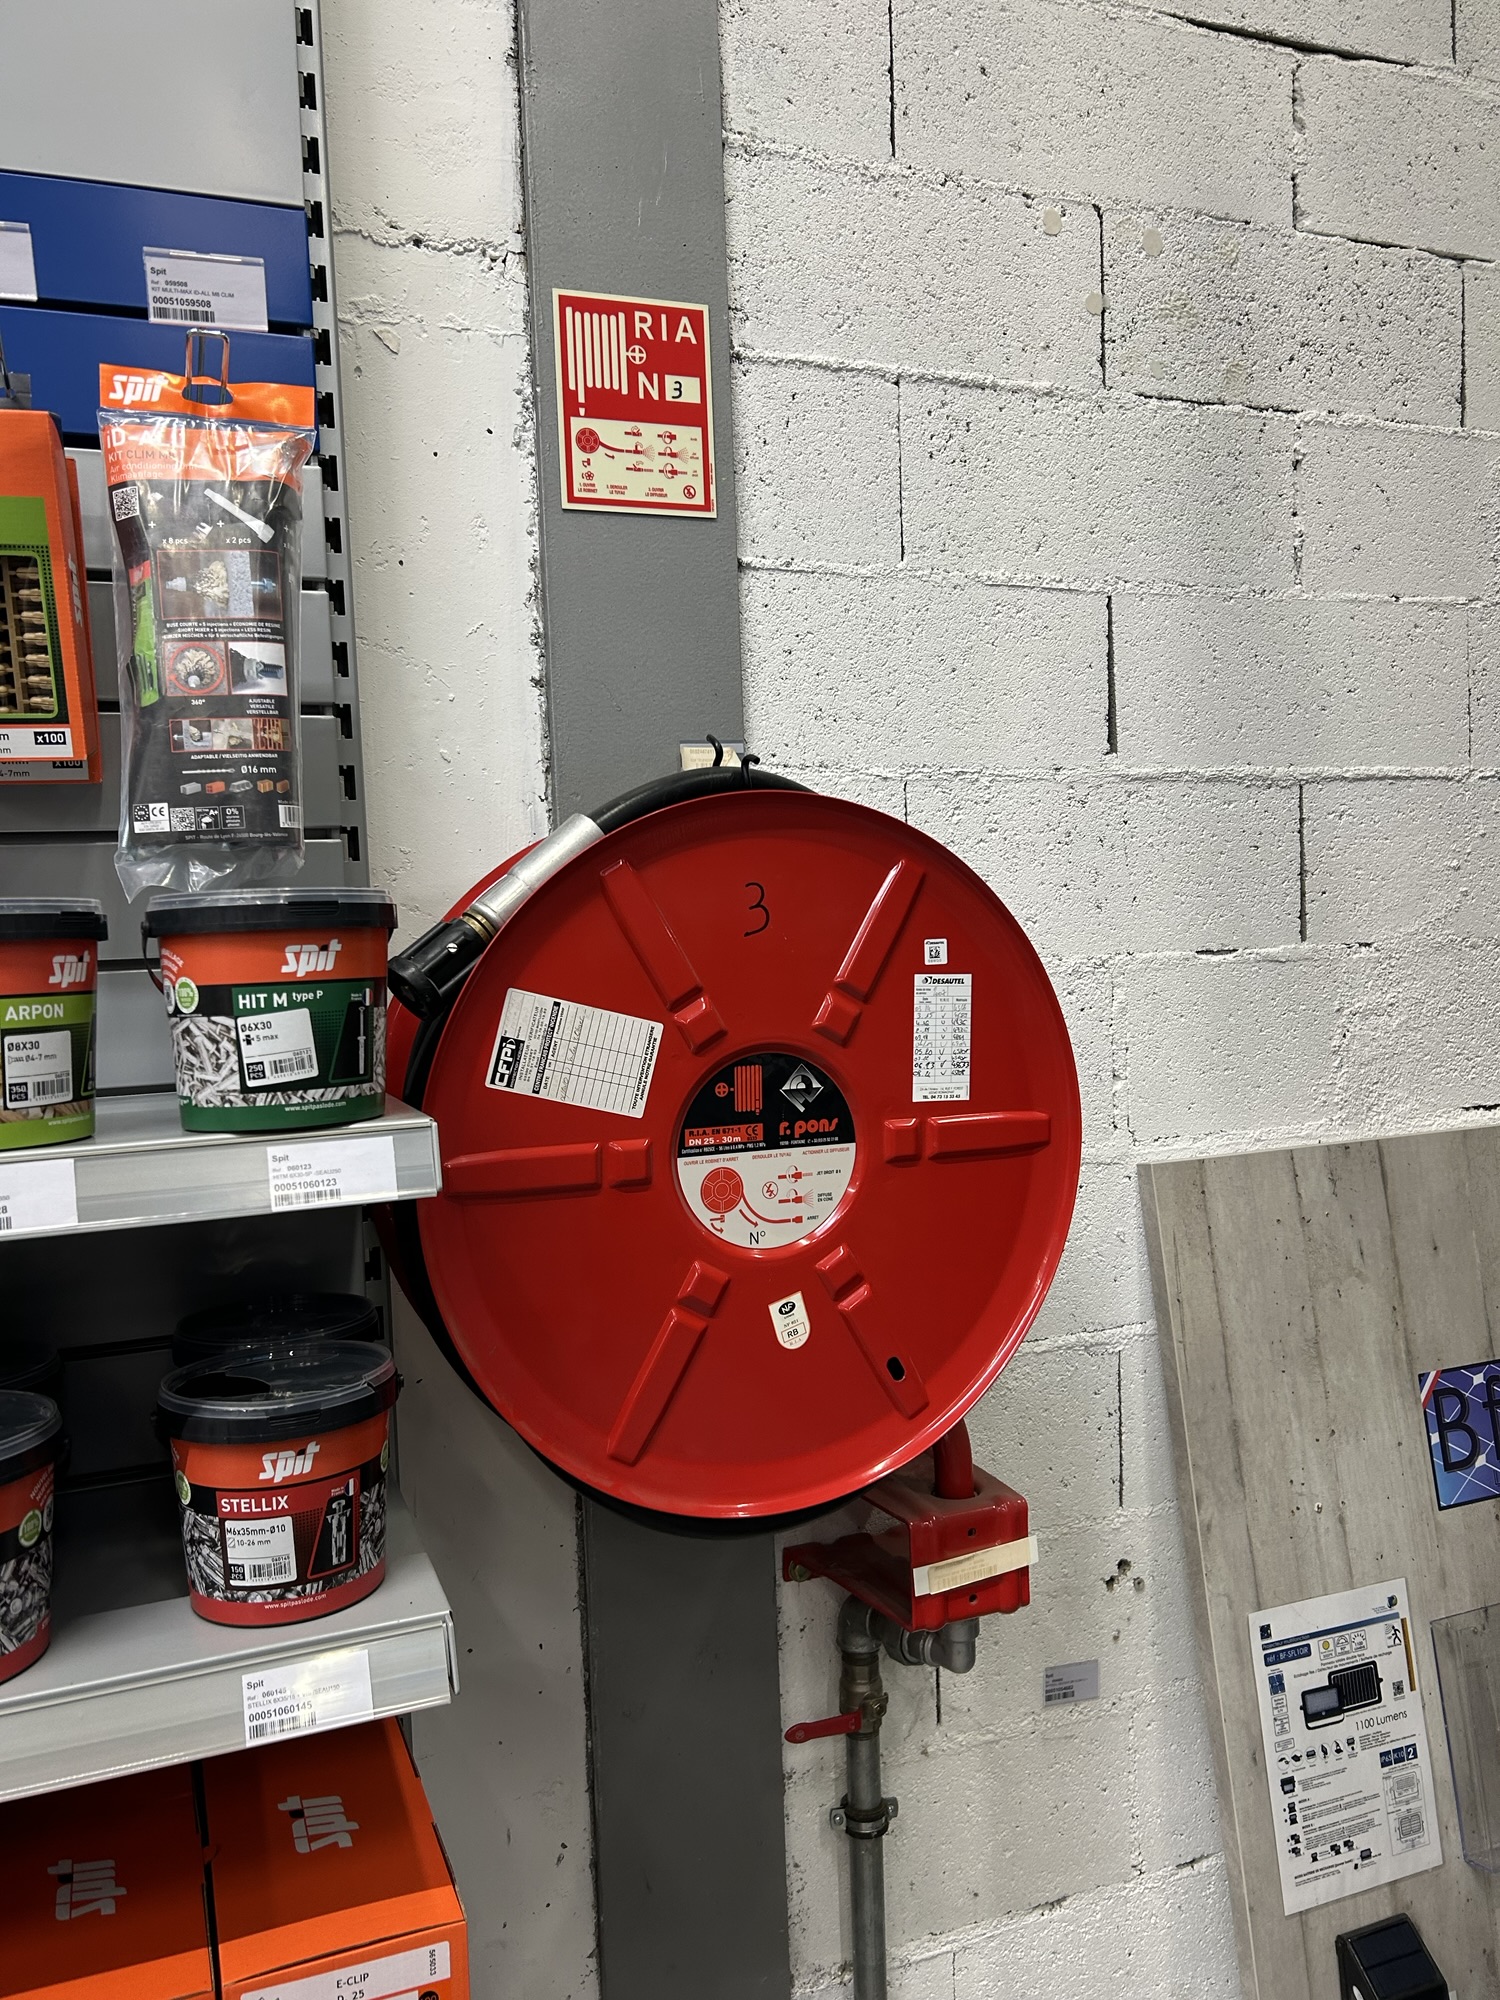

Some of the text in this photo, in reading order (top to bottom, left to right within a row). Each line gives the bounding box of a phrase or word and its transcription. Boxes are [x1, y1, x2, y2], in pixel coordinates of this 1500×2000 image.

[150, 267, 167, 276] Spit
[153, 296, 211, 308] 00051059508
[634, 311, 697, 344] RIA
[109, 375, 168, 405] spit
[638, 372, 682, 400] N 3
[108, 450, 155, 463] KIT CLIM
[36, 733, 64, 743] x100
[260, 766, 277, 774] mm
[744, 882, 770, 937] 3
[280, 938, 342, 977] spit
[48, 950, 90, 988] spit
[238, 990, 323, 1009] HIT M type P
[5, 1004, 64, 1021] ARPON
[240, 1021, 272, 1032] Ø6X30
[518, 1006, 540, 1081] INSTALLATEUR VERIFICATEUR
[534, 1072, 543, 1092] CENTRE
[549, 1006, 559, 1028] INCENDIE
[550, 1040, 558, 1058] AGENT
[647, 1037, 658, 1063] GARANTIE
[248, 1064, 263, 1072] 250
[631, 1026, 656, 1110] TOUTE INTERVENTION ETRANGERE
[643, 1062, 652, 1080] NOTRE
[722, 1127, 742, 1135] 671-1
[794, 1118, 839, 1138] pons
[689, 1138, 702, 1146] DN
[704, 1137, 715, 1145] 25
[272, 1154, 289, 1163] Spit
[274, 1178, 338, 1192] 00051060123
[750, 1231, 766, 1245] N°
[782, 1303, 793, 1314] NF
[787, 1328, 799, 1338] RB
[259, 1441, 320, 1483] spit
[221, 1496, 289, 1513] STELLIX
[247, 1680, 264, 1690] Spit
[262, 1688, 287, 1698] 060145
[249, 1701, 313, 1723] 00051060145
[1356, 1710, 1408, 1731] 1100 Lumens
[1408, 1748, 1414, 1759] 2
[336, 1973, 370, 1989] E-CLIP
[352, 1990, 365, 2000] 25
